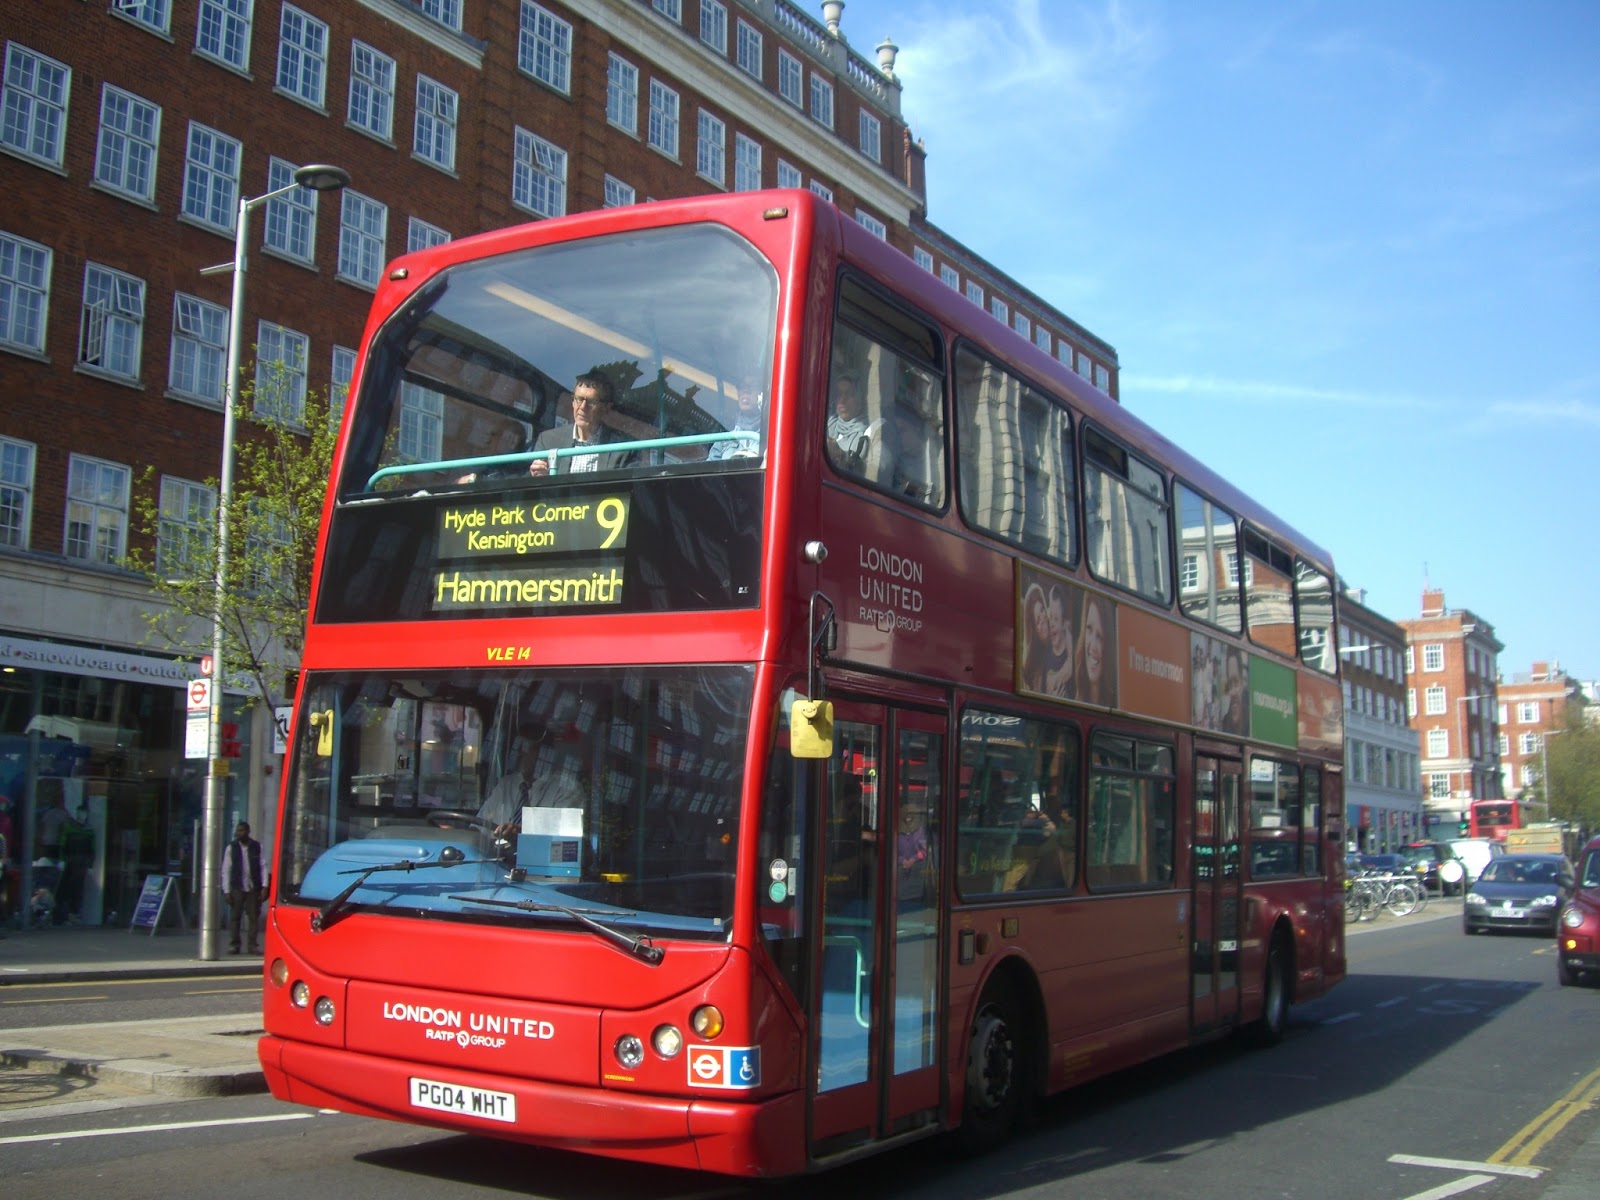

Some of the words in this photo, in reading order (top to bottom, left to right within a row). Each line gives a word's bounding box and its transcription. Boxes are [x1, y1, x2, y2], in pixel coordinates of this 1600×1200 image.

[444, 508, 486, 533] Hyde
[491, 505, 525, 526] Park
[532, 503, 590, 523] Corner
[596, 498, 625, 549] 9
[468, 530, 554, 554] Kensington
[859, 544, 923, 584] LONDON
[437, 568, 624, 602] Hammersmith
[859, 574, 923, 612] UNITED
[859, 606, 884, 622] RATP
[896, 615, 922, 632] GROUP
[23, 650, 128, 673] snowboard
[202, 660, 211, 675] U
[487, 647, 515, 661] VLE
[517, 646, 531, 660] 14
[1128, 645, 1145, 670] I'm
[1151, 658, 1184, 684] mormon
[384, 1001, 461, 1028] LONDON
[470, 1013, 555, 1040] UNITED
[426, 1028, 455, 1042] RATP
[470, 1036, 506, 1048] GROUP
[418, 1082, 465, 1110] PG04
[471, 1091, 508, 1117] WHT
